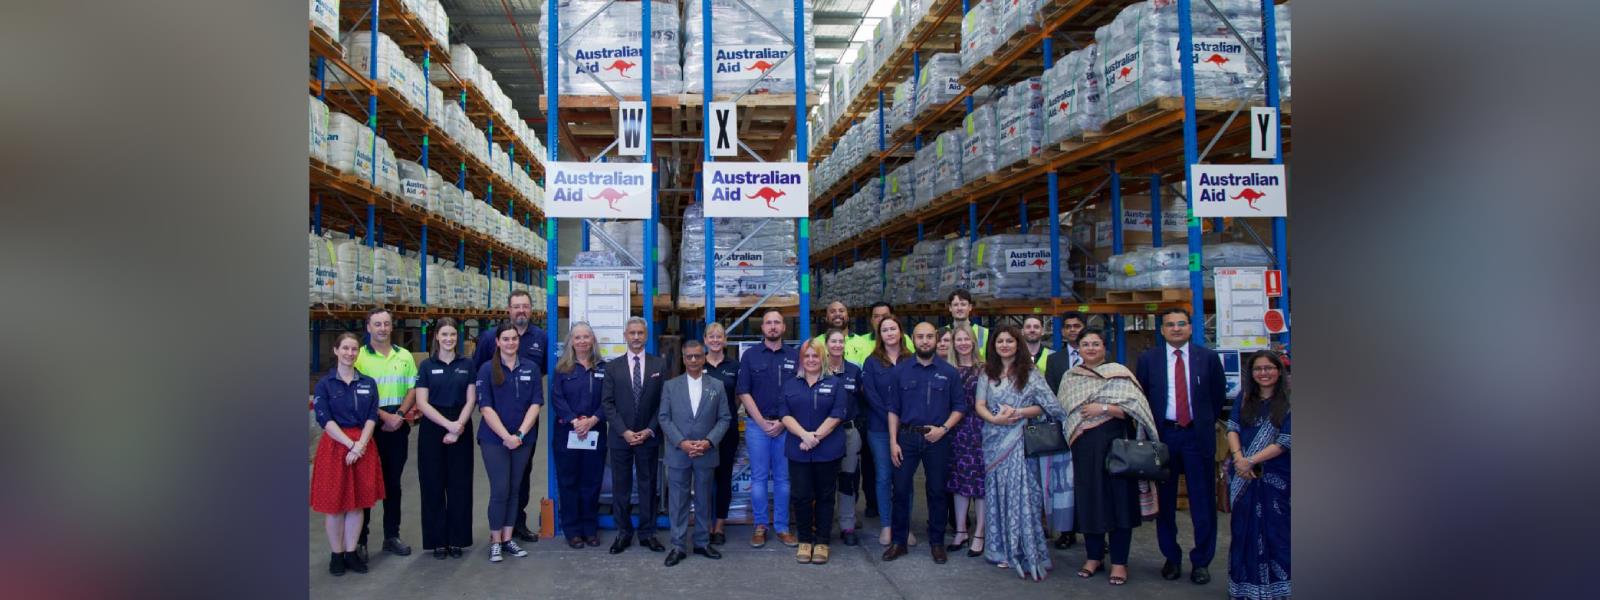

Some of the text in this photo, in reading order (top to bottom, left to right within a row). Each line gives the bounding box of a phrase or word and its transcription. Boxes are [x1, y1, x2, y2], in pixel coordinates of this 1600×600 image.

[716, 48, 788, 60] Australian
[717, 62, 740, 73] Aid
[622, 108, 643, 148] W
[716, 109, 730, 149] X
[1257, 114, 1270, 151] Y
[554, 170, 644, 185] Australian
[712, 170, 801, 184] Australian
[1199, 173, 1279, 185] Australian
[553, 188, 583, 201] Aid
[712, 187, 741, 201] Aid
[1200, 189, 1225, 202] Aid
[1010, 250, 1050, 258] Australia
